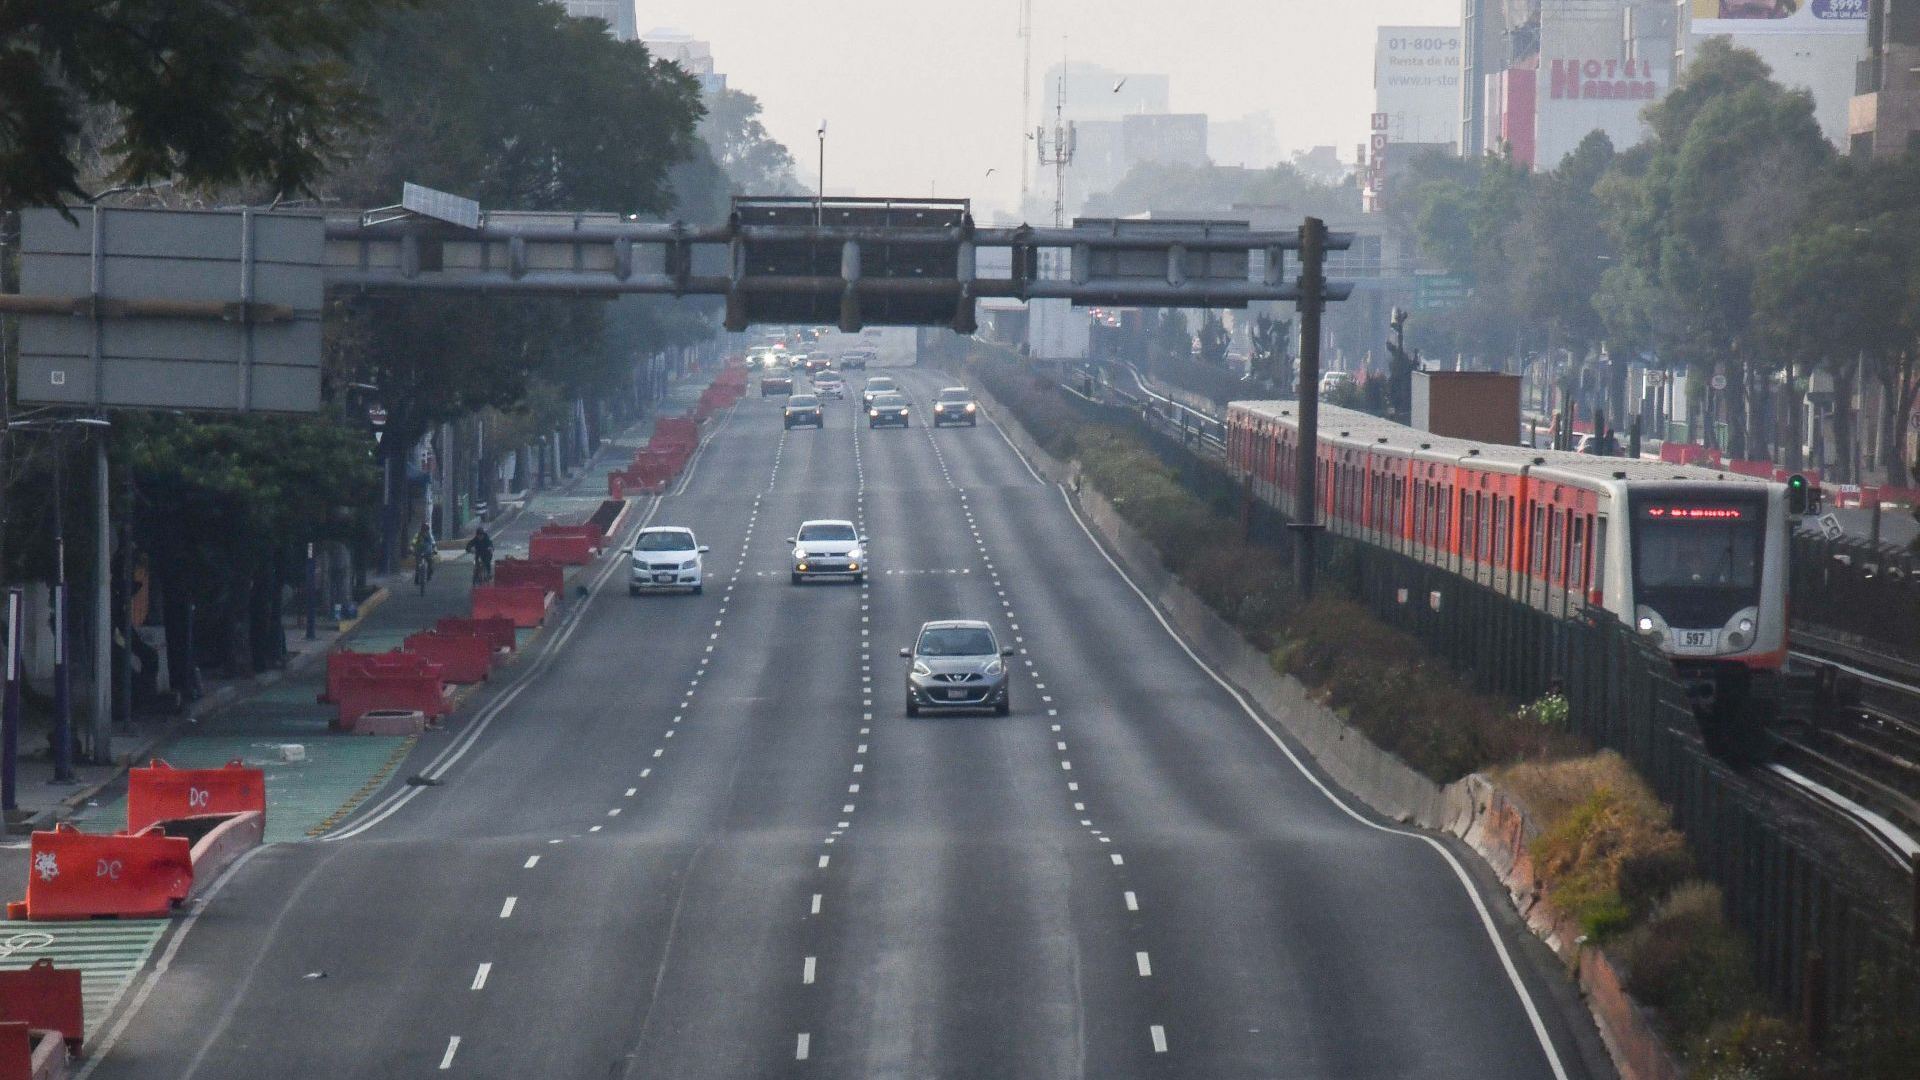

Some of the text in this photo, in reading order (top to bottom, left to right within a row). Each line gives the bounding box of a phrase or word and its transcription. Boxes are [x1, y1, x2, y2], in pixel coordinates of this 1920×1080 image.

[1389, 38, 1460, 50] 01-800-9
[1390, 55, 1423, 66] Renta
[1374, 115, 1385, 211] HOTEL
[1686, 632, 1704, 645] 597
